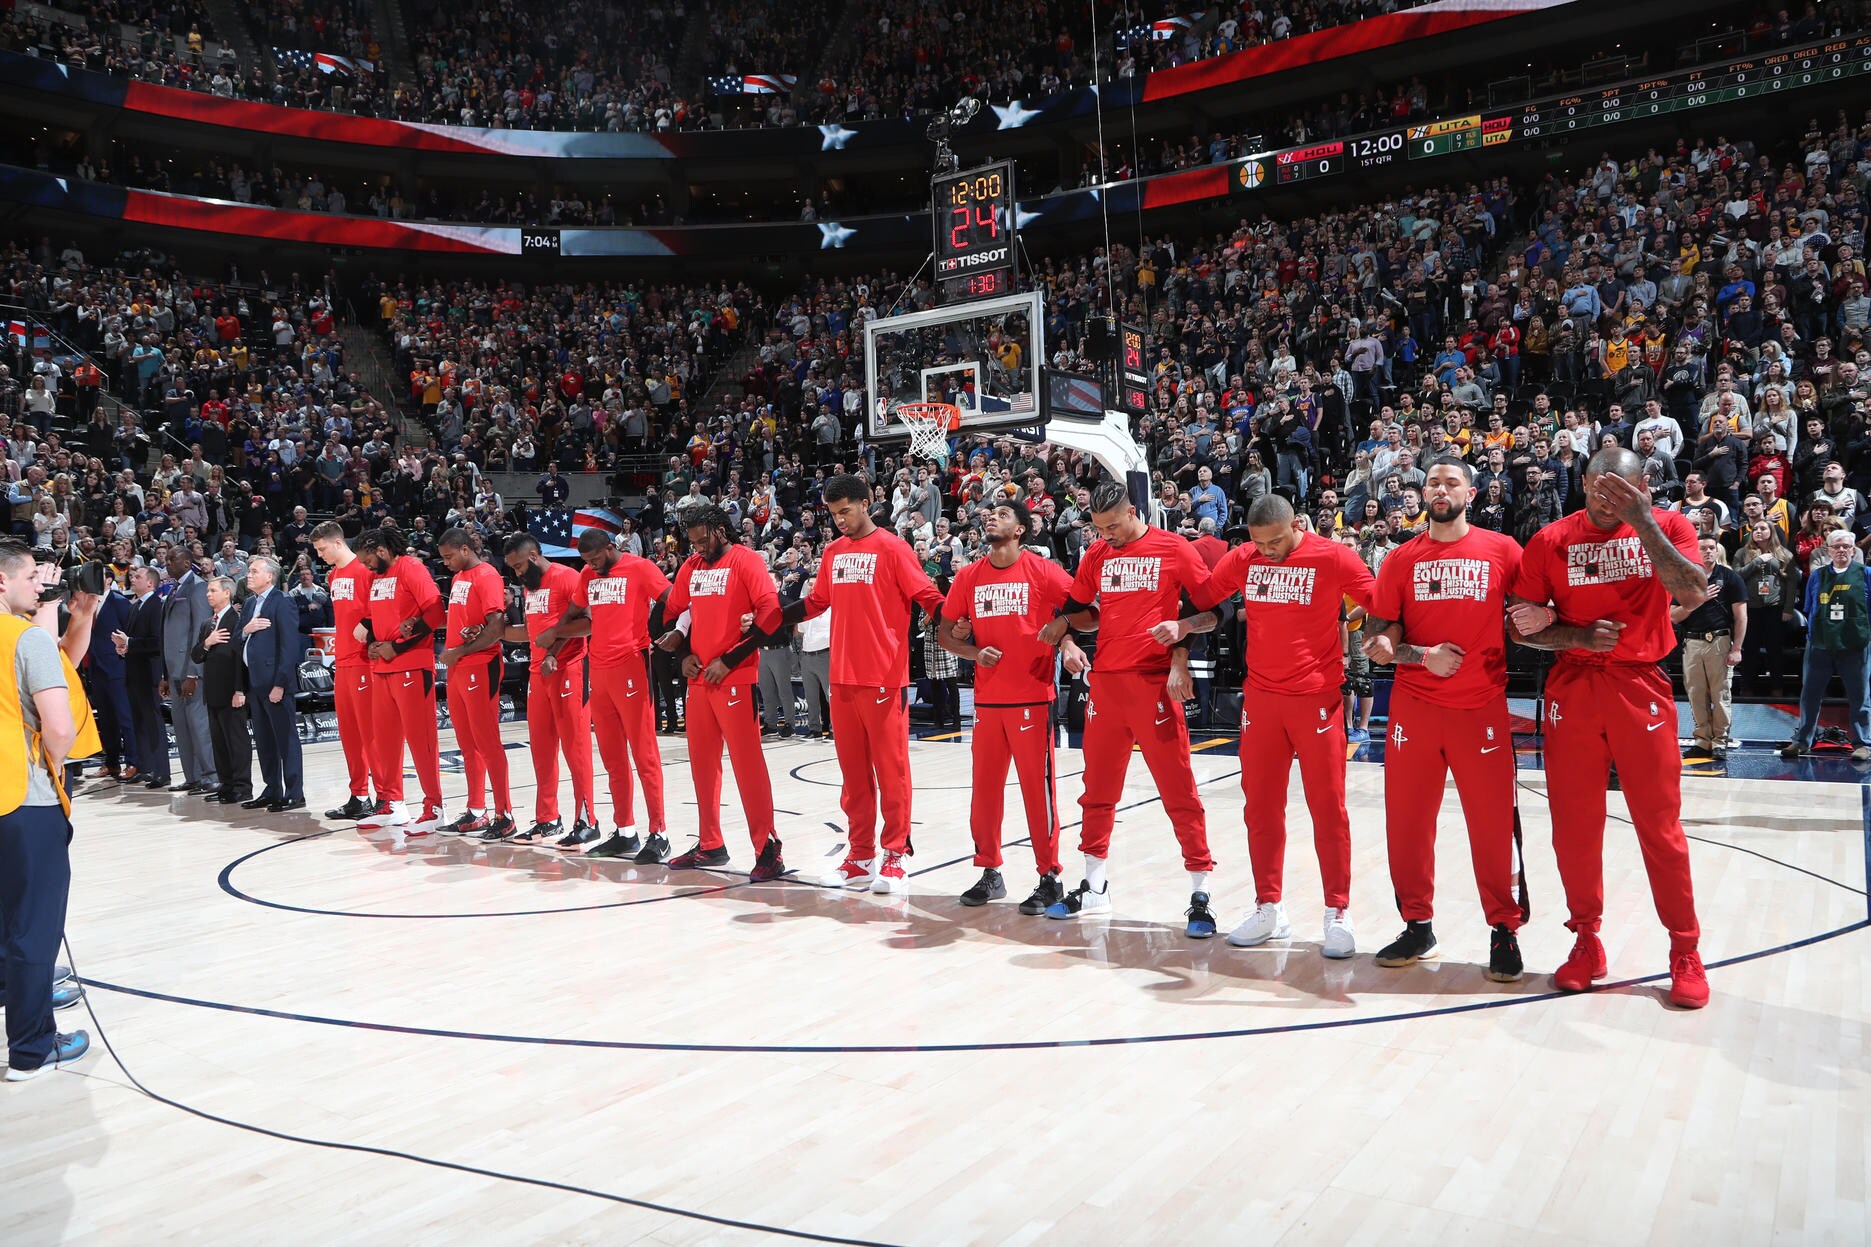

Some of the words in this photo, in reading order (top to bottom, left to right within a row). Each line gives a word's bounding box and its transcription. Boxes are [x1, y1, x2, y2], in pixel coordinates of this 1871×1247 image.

[1439, 119, 1471, 132] UTA
[1484, 119, 1507, 131] HOU
[1485, 133, 1507, 144] UTA
[1304, 145, 1337, 158] HOU
[1350, 134, 1403, 158] 12:00
[1424, 140, 1434, 153] 0
[1319, 160, 1330, 173] 0
[1361, 157, 1373, 167] 1ST
[1376, 155, 1392, 165] QTR
[951, 174, 1000, 205] 12:00
[951, 204, 997, 249] 24
[523, 235, 550, 248] 7:04
[957, 248, 1008, 268] TISSOT
[970, 274, 995, 294] 1:30
[1126, 347, 1140, 368] 24
[1649, 352, 1660, 362] 27
[1568, 542, 1595, 554] UNIFY
[1618, 536, 1641, 547] LEAD
[1137, 556, 1154, 564] LEAD
[1567, 545, 1641, 567] EQUALITY
[832, 558, 871, 570] EQUALITY
[1101, 563, 1154, 577] EQUALITY
[1249, 565, 1270, 573] UNIFY
[1290, 567, 1309, 575] LEAD
[1414, 561, 1438, 570] UNIFY
[1461, 558, 1482, 567] LEAD
[1604, 557, 1642, 571] HISTORY
[1246, 571, 1307, 586] EQUALITY
[1413, 565, 1482, 583] EQUALITY
[1605, 566, 1638, 579] JUSTICE
[1447, 579, 1480, 589] HISTORY
[1568, 576, 1599, 587] DREAM
[974, 588, 1022, 603] EQUALITY
[1273, 584, 1305, 594] HISTORY
[1447, 587, 1475, 596] JUSTICE
[1272, 592, 1299, 600] JUSTICE
[1415, 593, 1441, 601] DREAM
[300, 668, 331, 679] Smith's
